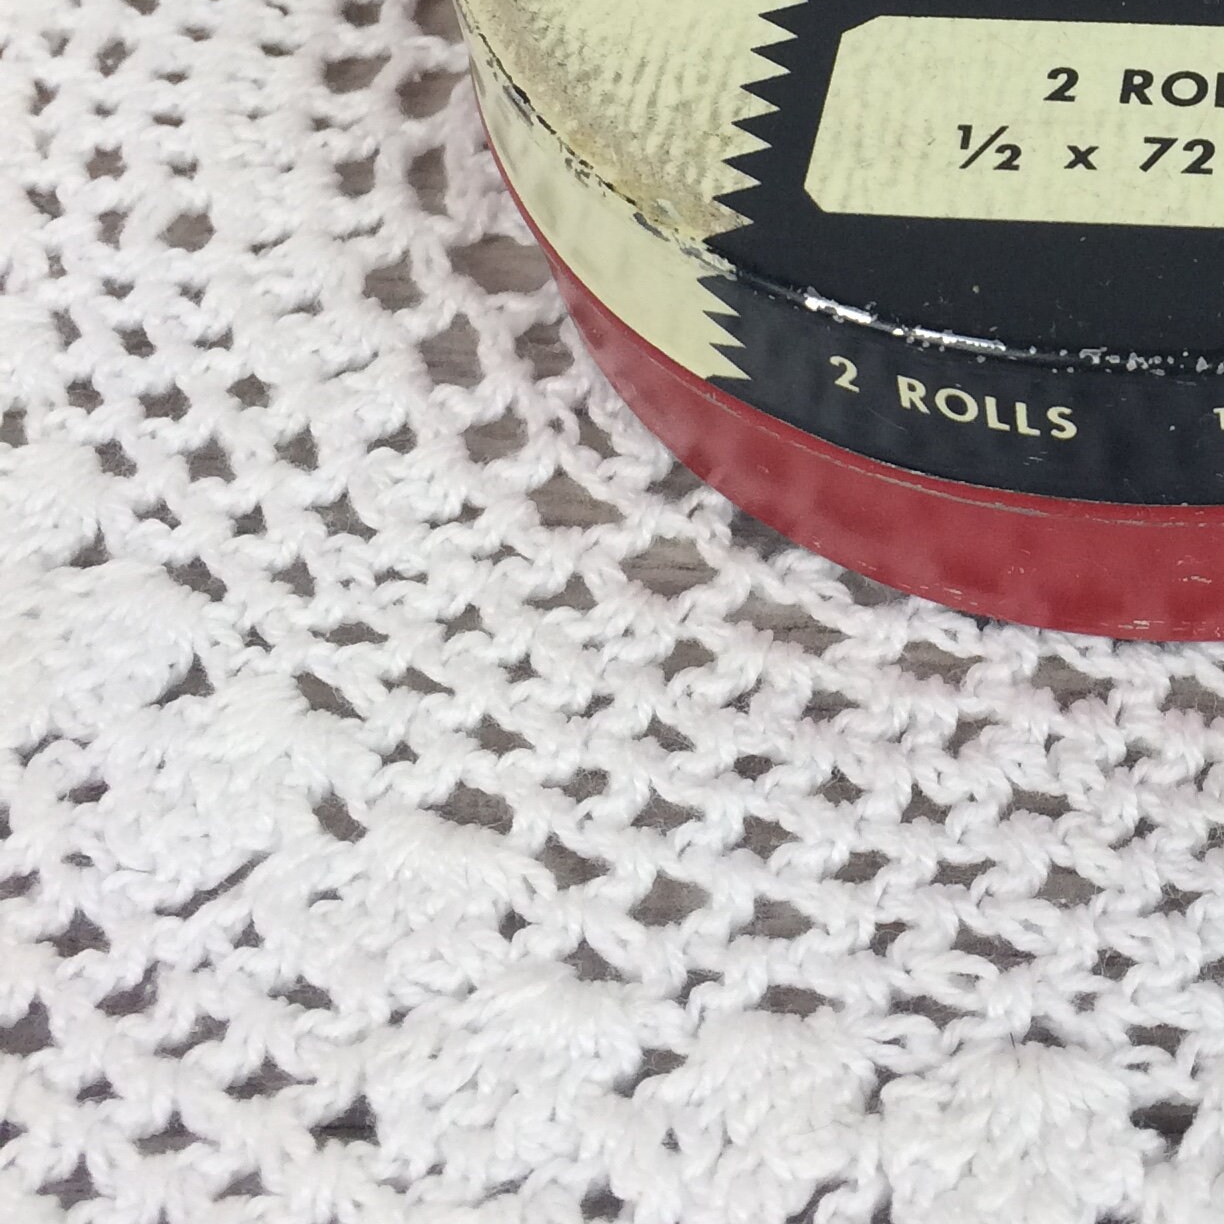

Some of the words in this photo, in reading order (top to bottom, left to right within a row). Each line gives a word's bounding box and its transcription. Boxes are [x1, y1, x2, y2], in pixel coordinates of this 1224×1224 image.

[1043, 66, 1079, 103] 2
[1138, 136, 1216, 175] 72
[829, 355, 860, 393] 2
[897, 374, 1078, 439] ROLLS
